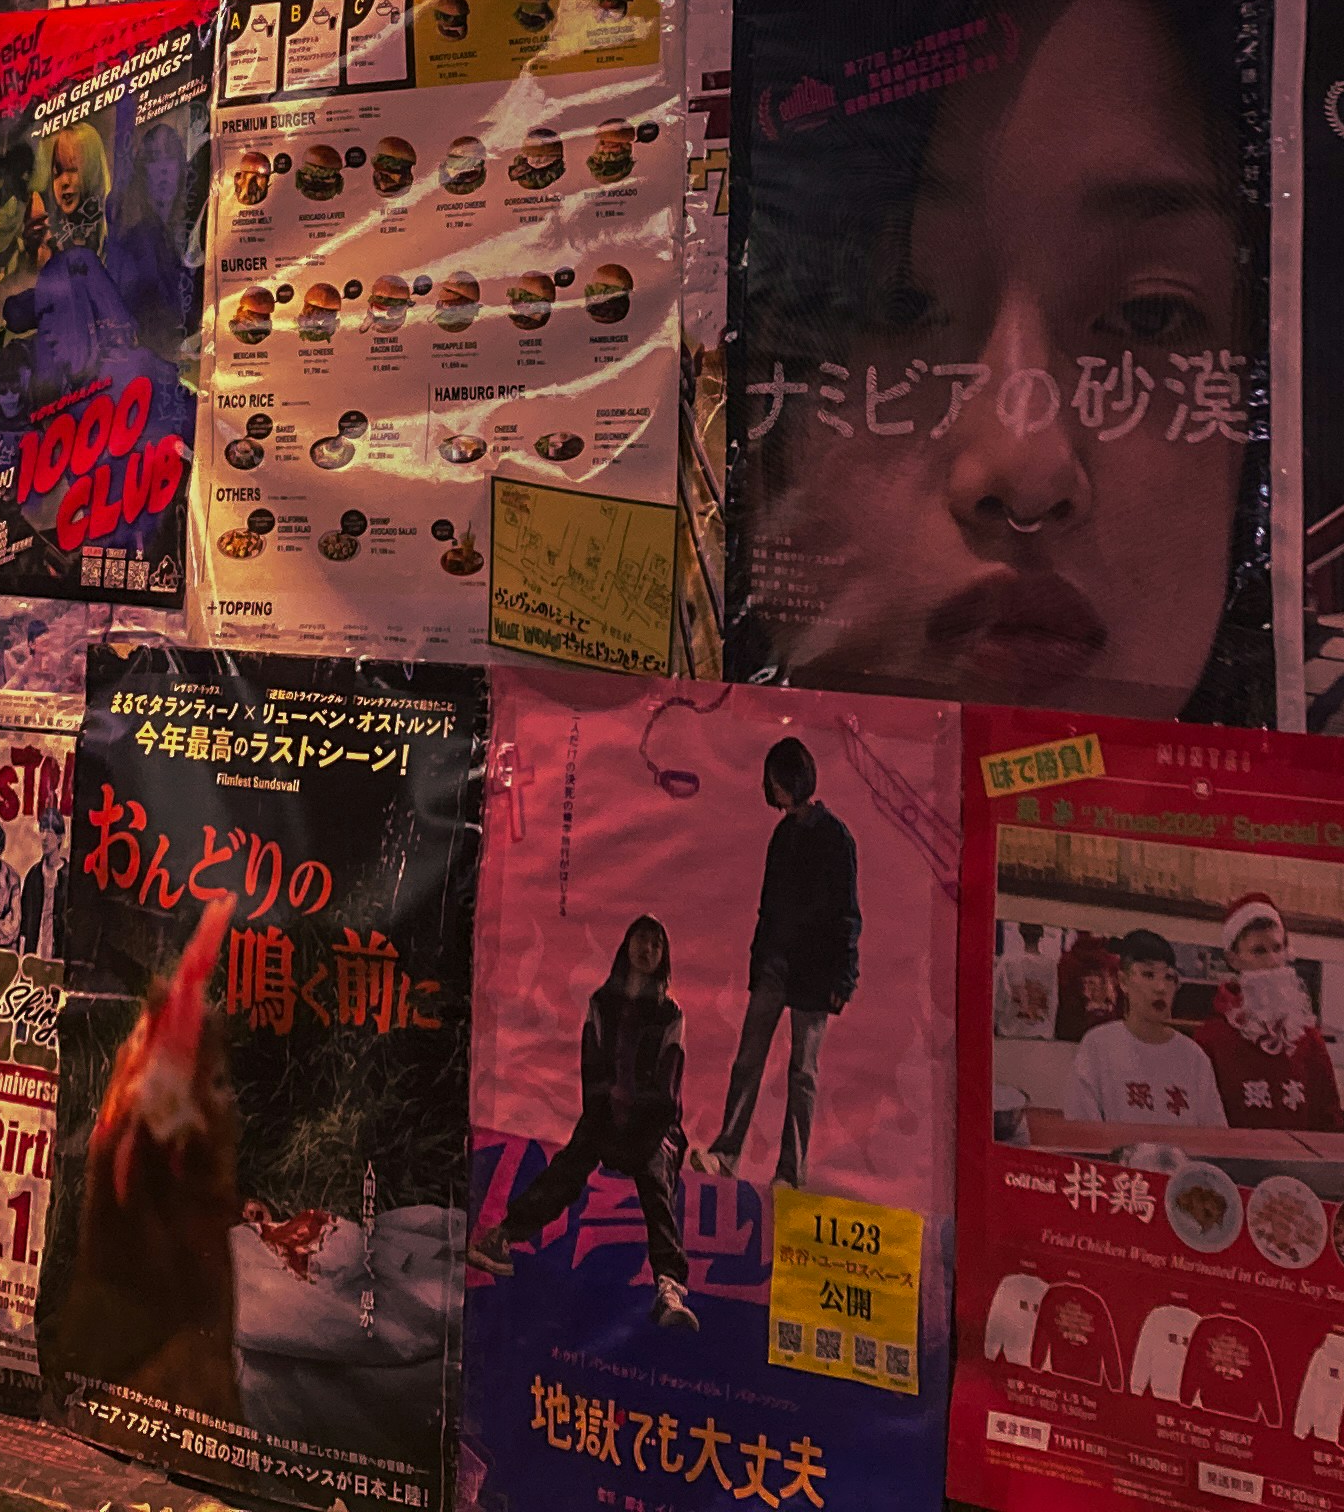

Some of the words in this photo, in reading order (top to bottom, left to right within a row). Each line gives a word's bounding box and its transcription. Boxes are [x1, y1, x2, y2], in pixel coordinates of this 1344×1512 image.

[230, 13, 240, 31] A
[291, 4, 301, 24] B
[34, 97, 67, 120] OUR
[70, 40, 169, 103] GENERATION
[93, 84, 125, 112] END
[221, 115, 268, 134] PREMIUM
[270, 111, 316, 130] BURGER
[221, 257, 268, 273] BURGER
[217, 394, 247, 410] TACO
[249, 392, 275, 409] RICE
[434, 386, 495, 402] HAMBURG
[497, 384, 527, 400] RICE
[746, 349, 1254, 443] ナミビアの砂漠
[17, 376, 154, 505] 1000
[57, 434, 185, 552] CLUB
[216, 487, 261, 503] OTHERS
[110, 691, 239, 721] まるでタランティーノ
[261, 706, 457, 738] リューベン・オストルンド
[135, 720, 412, 776] 今年最高のラストシーン!
[988, 738, 1096, 791] 味で勝負!
[216, 772, 252, 788] Filmfest
[253, 777, 301, 792] Sundsvall
[83, 781, 334, 919] おんどりの
[1233, 814, 1320, 847] Special
[226, 925, 445, 1041] 鳴く前に
[814, 1214, 882, 1256] 11.23
[779, 1245, 916, 1290] 渋谷・ユーロスペース
[1041, 1228, 1076, 1250] Fried
[1078, 1233, 1126, 1258] Chicken
[1130, 1244, 1168, 1270] Wings
[1170, 1253, 1237, 1280] Marinated
[1238, 1265, 1252, 1282] in
[1254, 1270, 1297, 1293] Garlic
[1299, 1278, 1324, 1300] Soy
[819, 1280, 873, 1322] 公開
[530, 1374, 827, 1509] 地獄でも大丈夫
